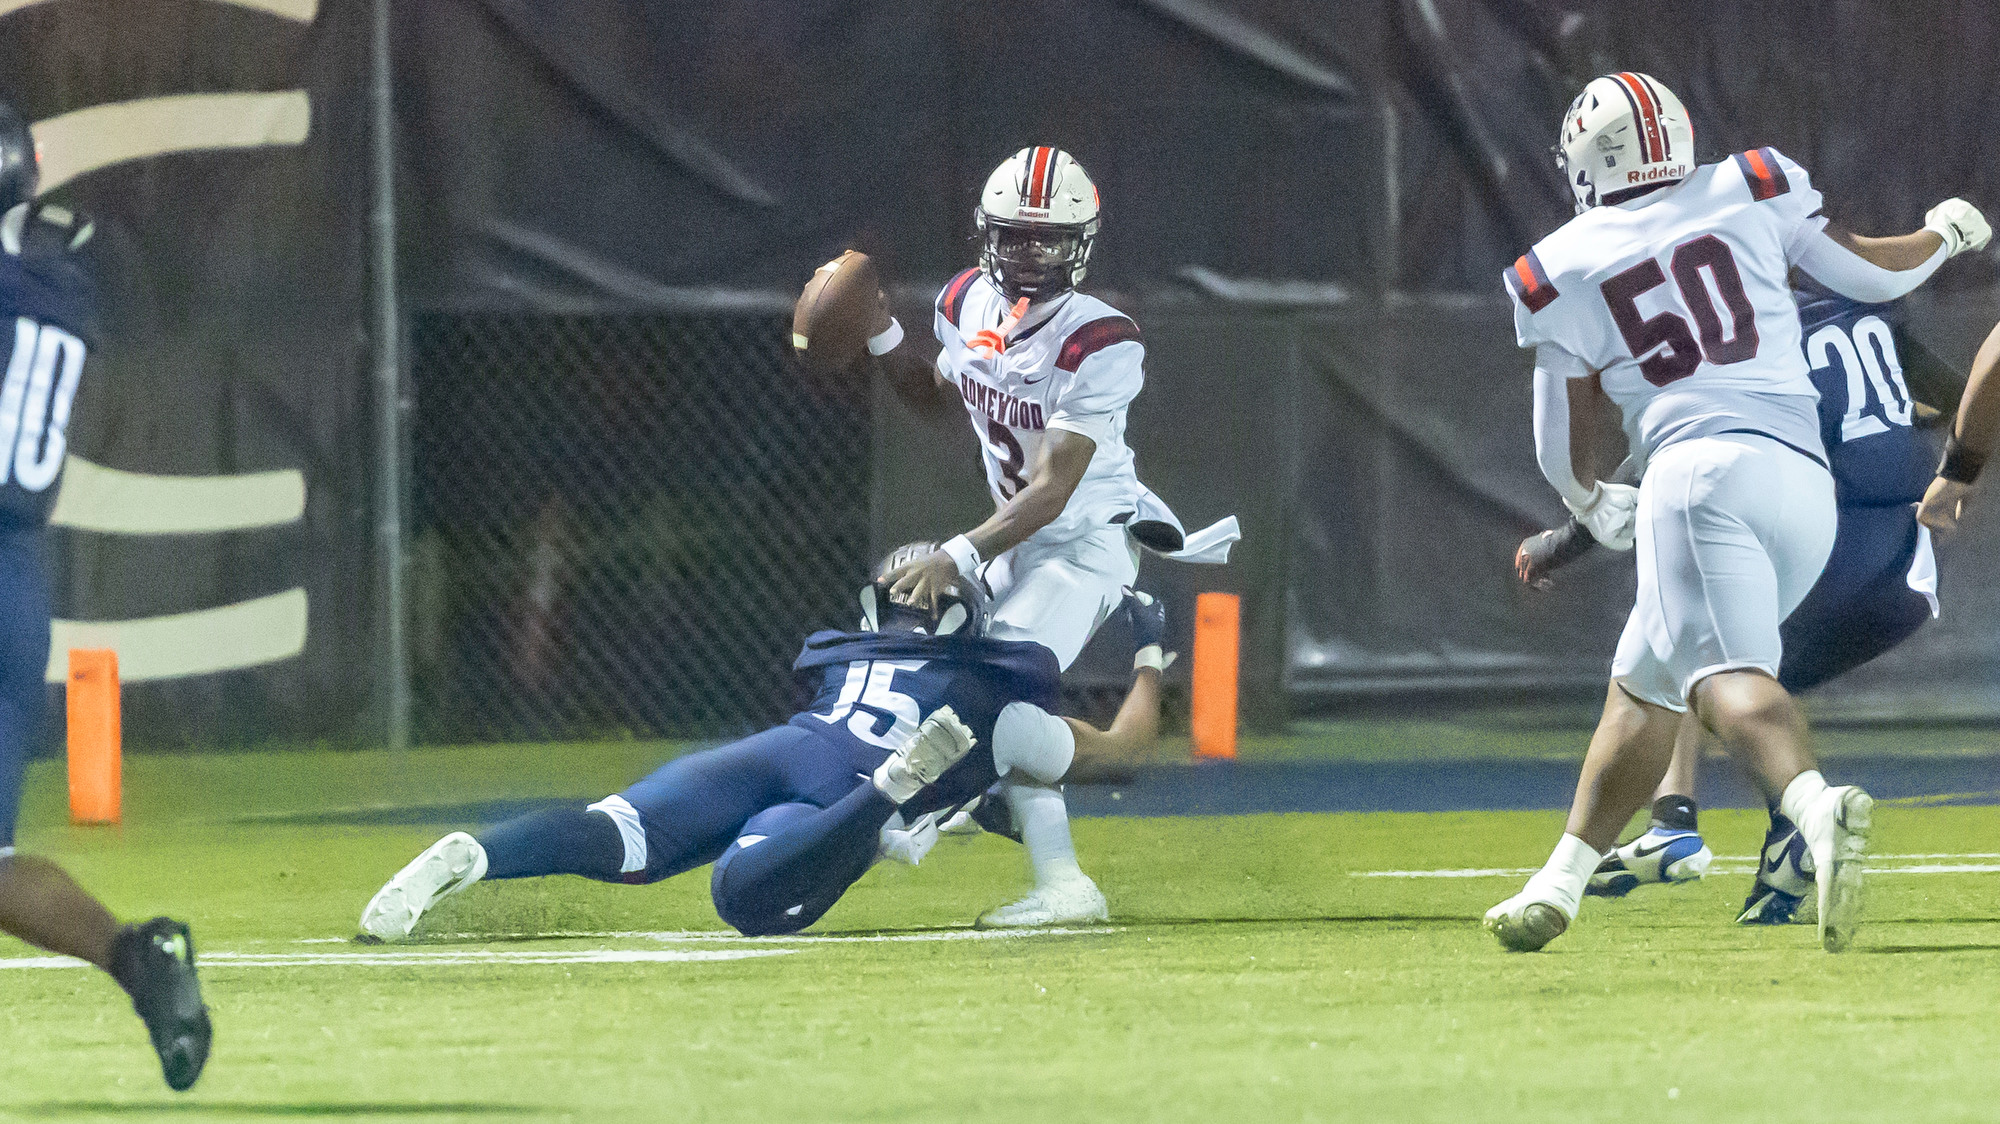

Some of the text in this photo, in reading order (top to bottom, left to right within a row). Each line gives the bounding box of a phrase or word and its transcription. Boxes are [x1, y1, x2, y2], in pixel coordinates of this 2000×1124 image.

[1627, 165, 1686, 184] Riddell
[1600, 234, 1760, 387] 50
[0, 316, 86, 492] 10
[960, 371, 1046, 431] HOMEWOOD
[1807, 316, 1913, 441] 20
[987, 417, 1030, 502] 3
[811, 659, 930, 751] 15
